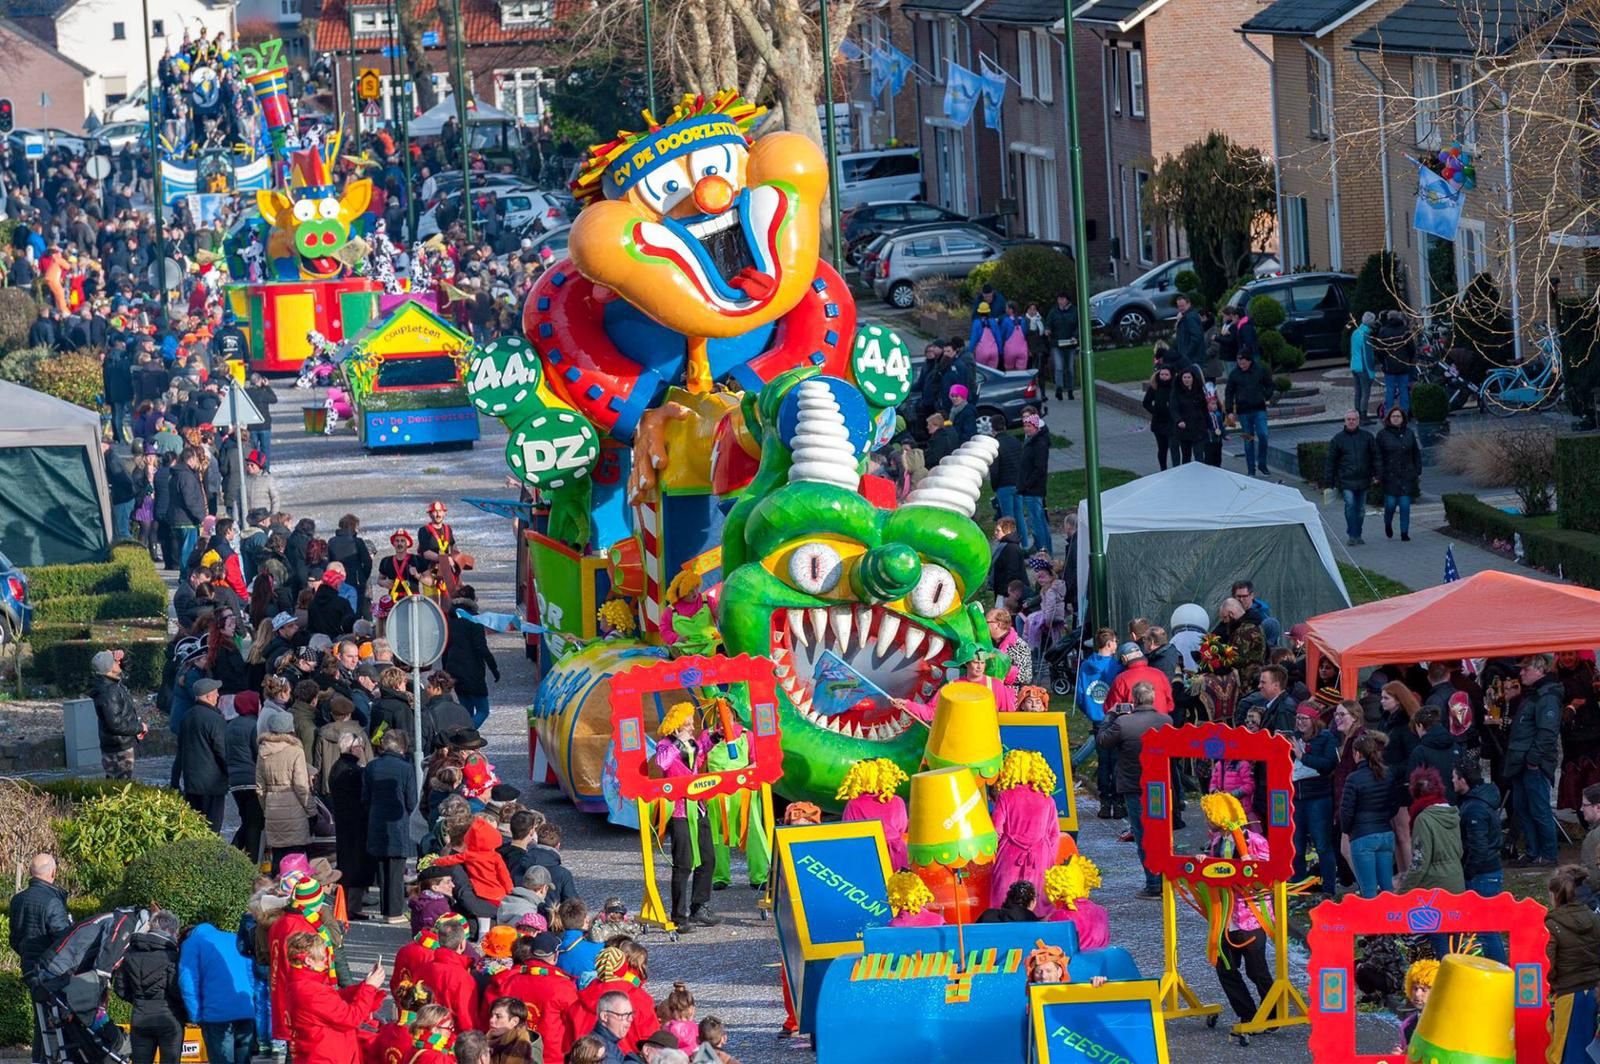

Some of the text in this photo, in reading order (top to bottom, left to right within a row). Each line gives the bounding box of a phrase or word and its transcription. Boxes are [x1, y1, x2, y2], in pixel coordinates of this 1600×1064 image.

[233, 37, 288, 79] DZ
[613, 162, 631, 186] CV
[632, 146, 656, 169] DE
[474, 352, 529, 391] 44
[863, 339, 908, 382] 44
[523, 434, 590, 473] DZ
[797, 855, 888, 917] FEESTICIJN
